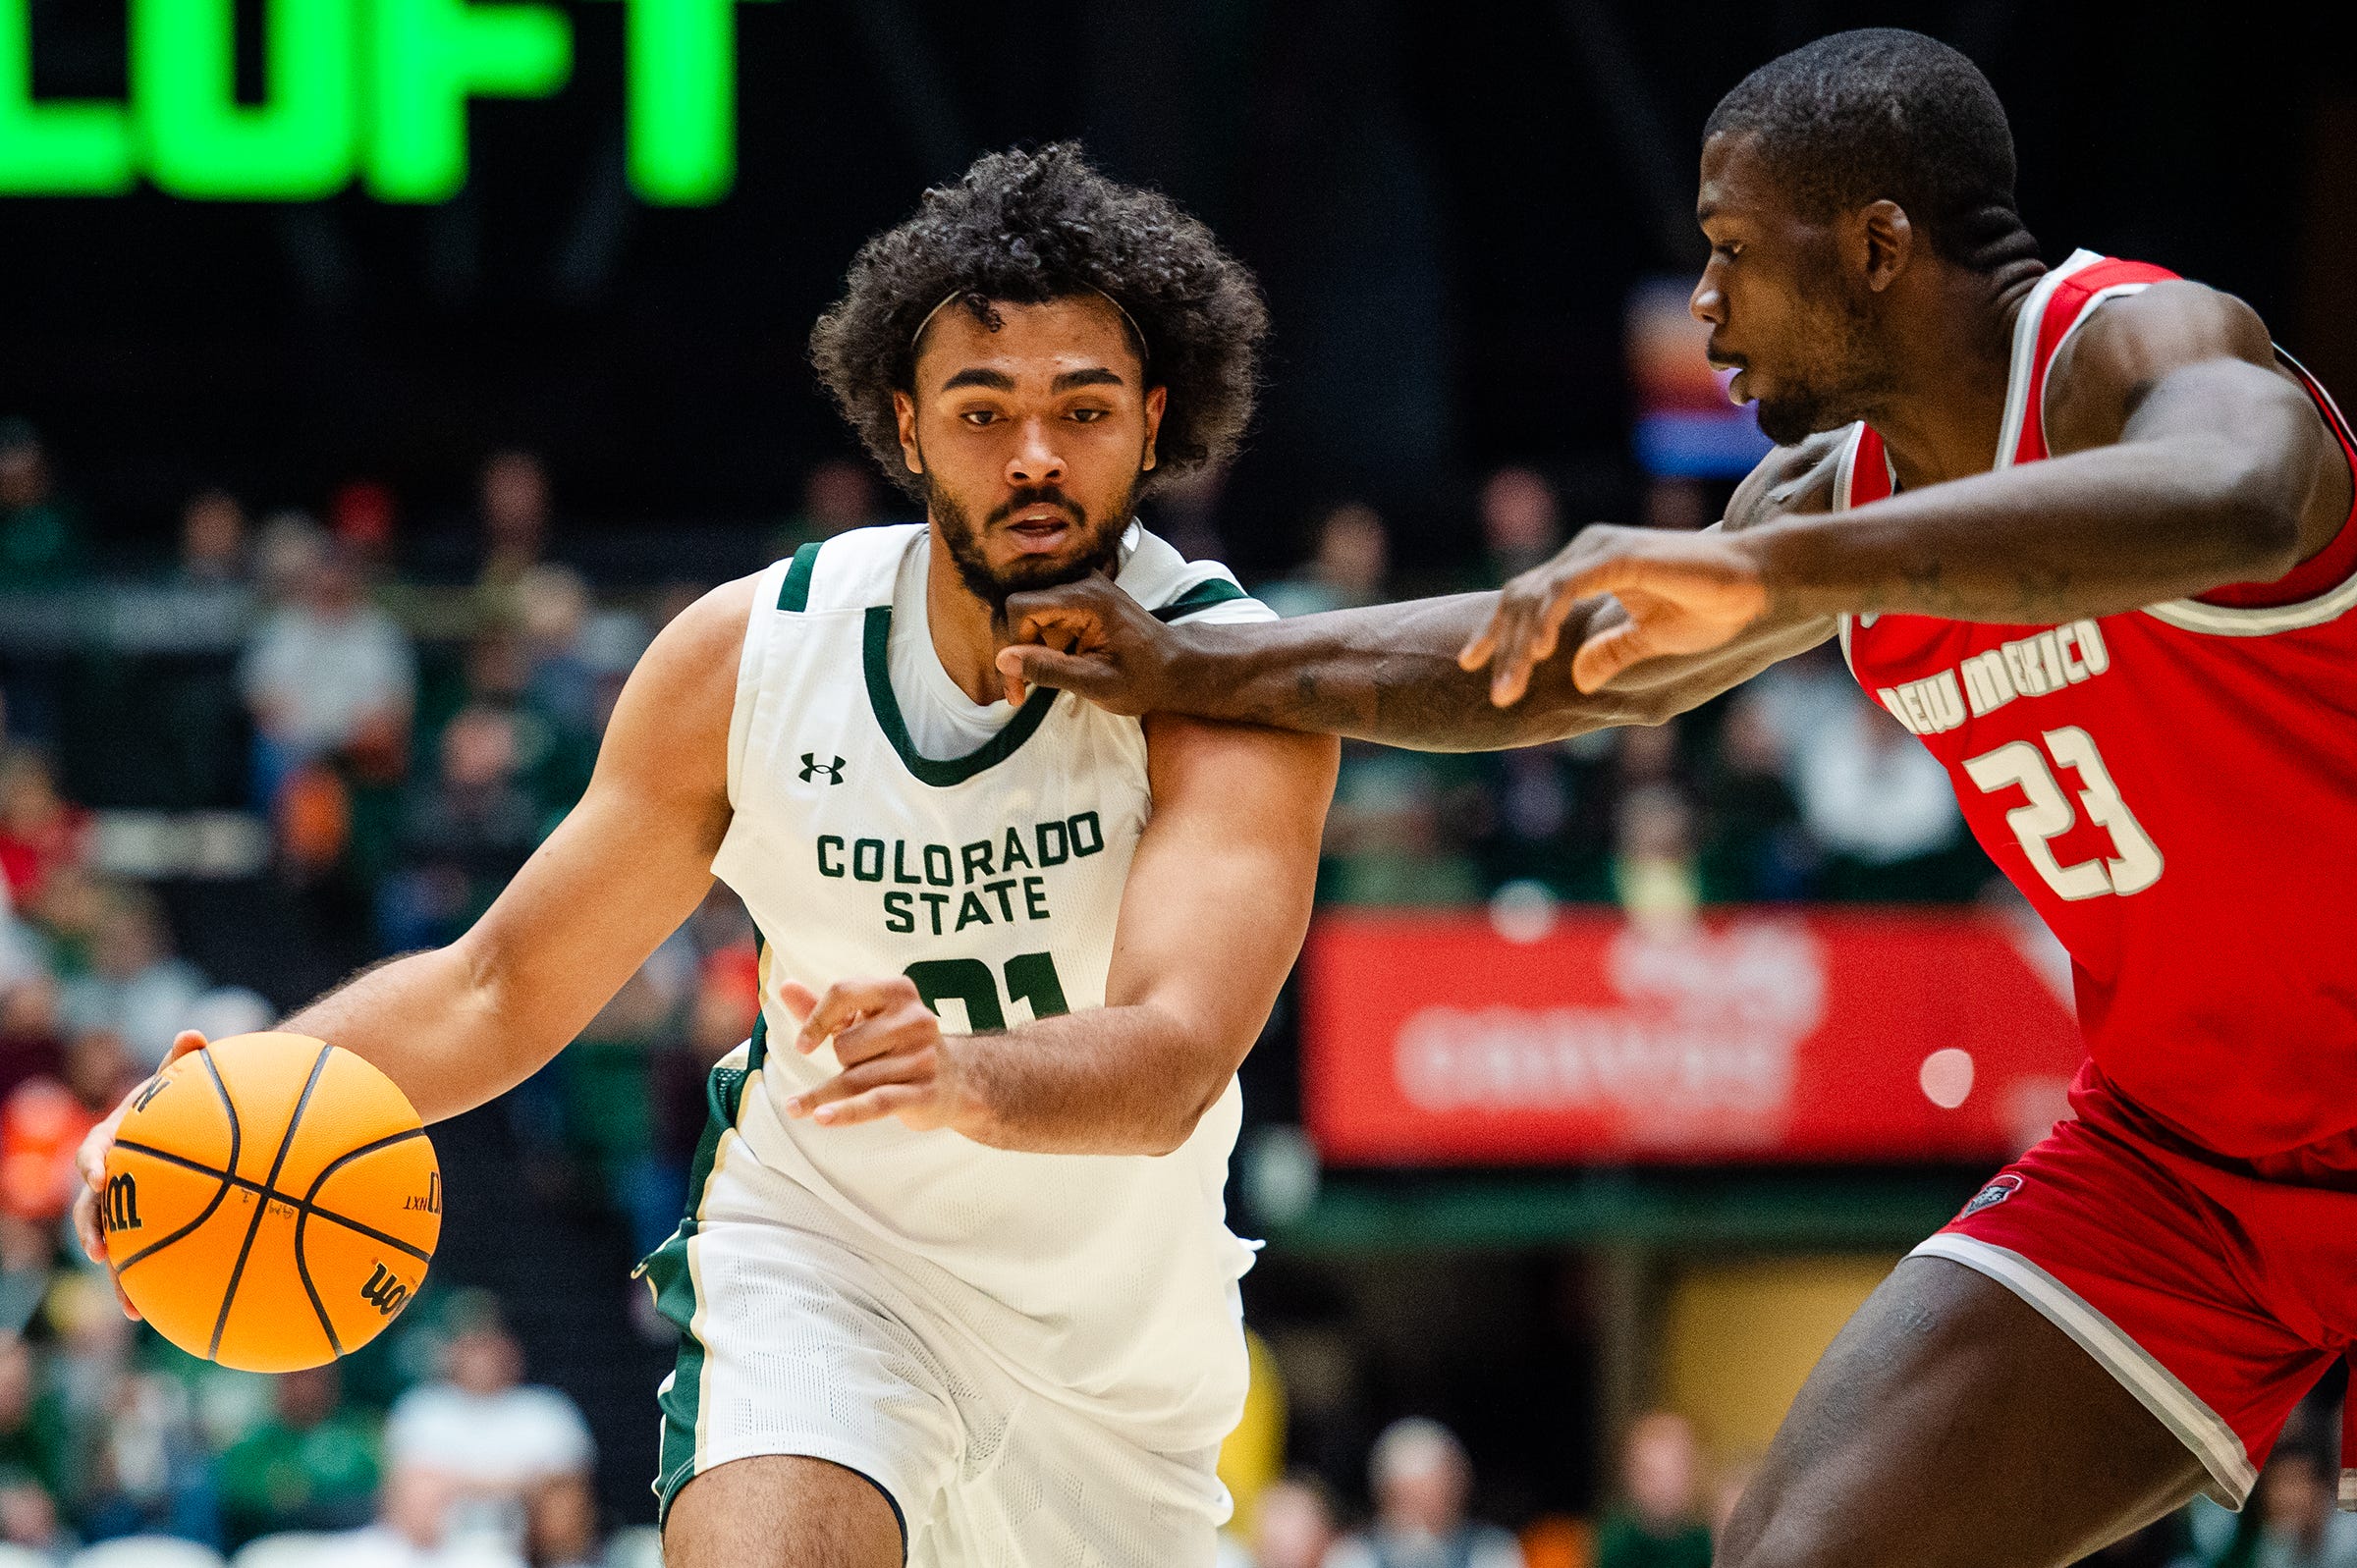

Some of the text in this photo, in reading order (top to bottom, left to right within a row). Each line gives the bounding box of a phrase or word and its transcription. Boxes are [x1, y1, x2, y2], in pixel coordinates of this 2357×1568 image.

[1960, 618, 2110, 718] MEXICO
[816, 810, 1105, 888] COLORADO
[1961, 725, 2165, 901] 23
[884, 876, 1051, 936] STATE
